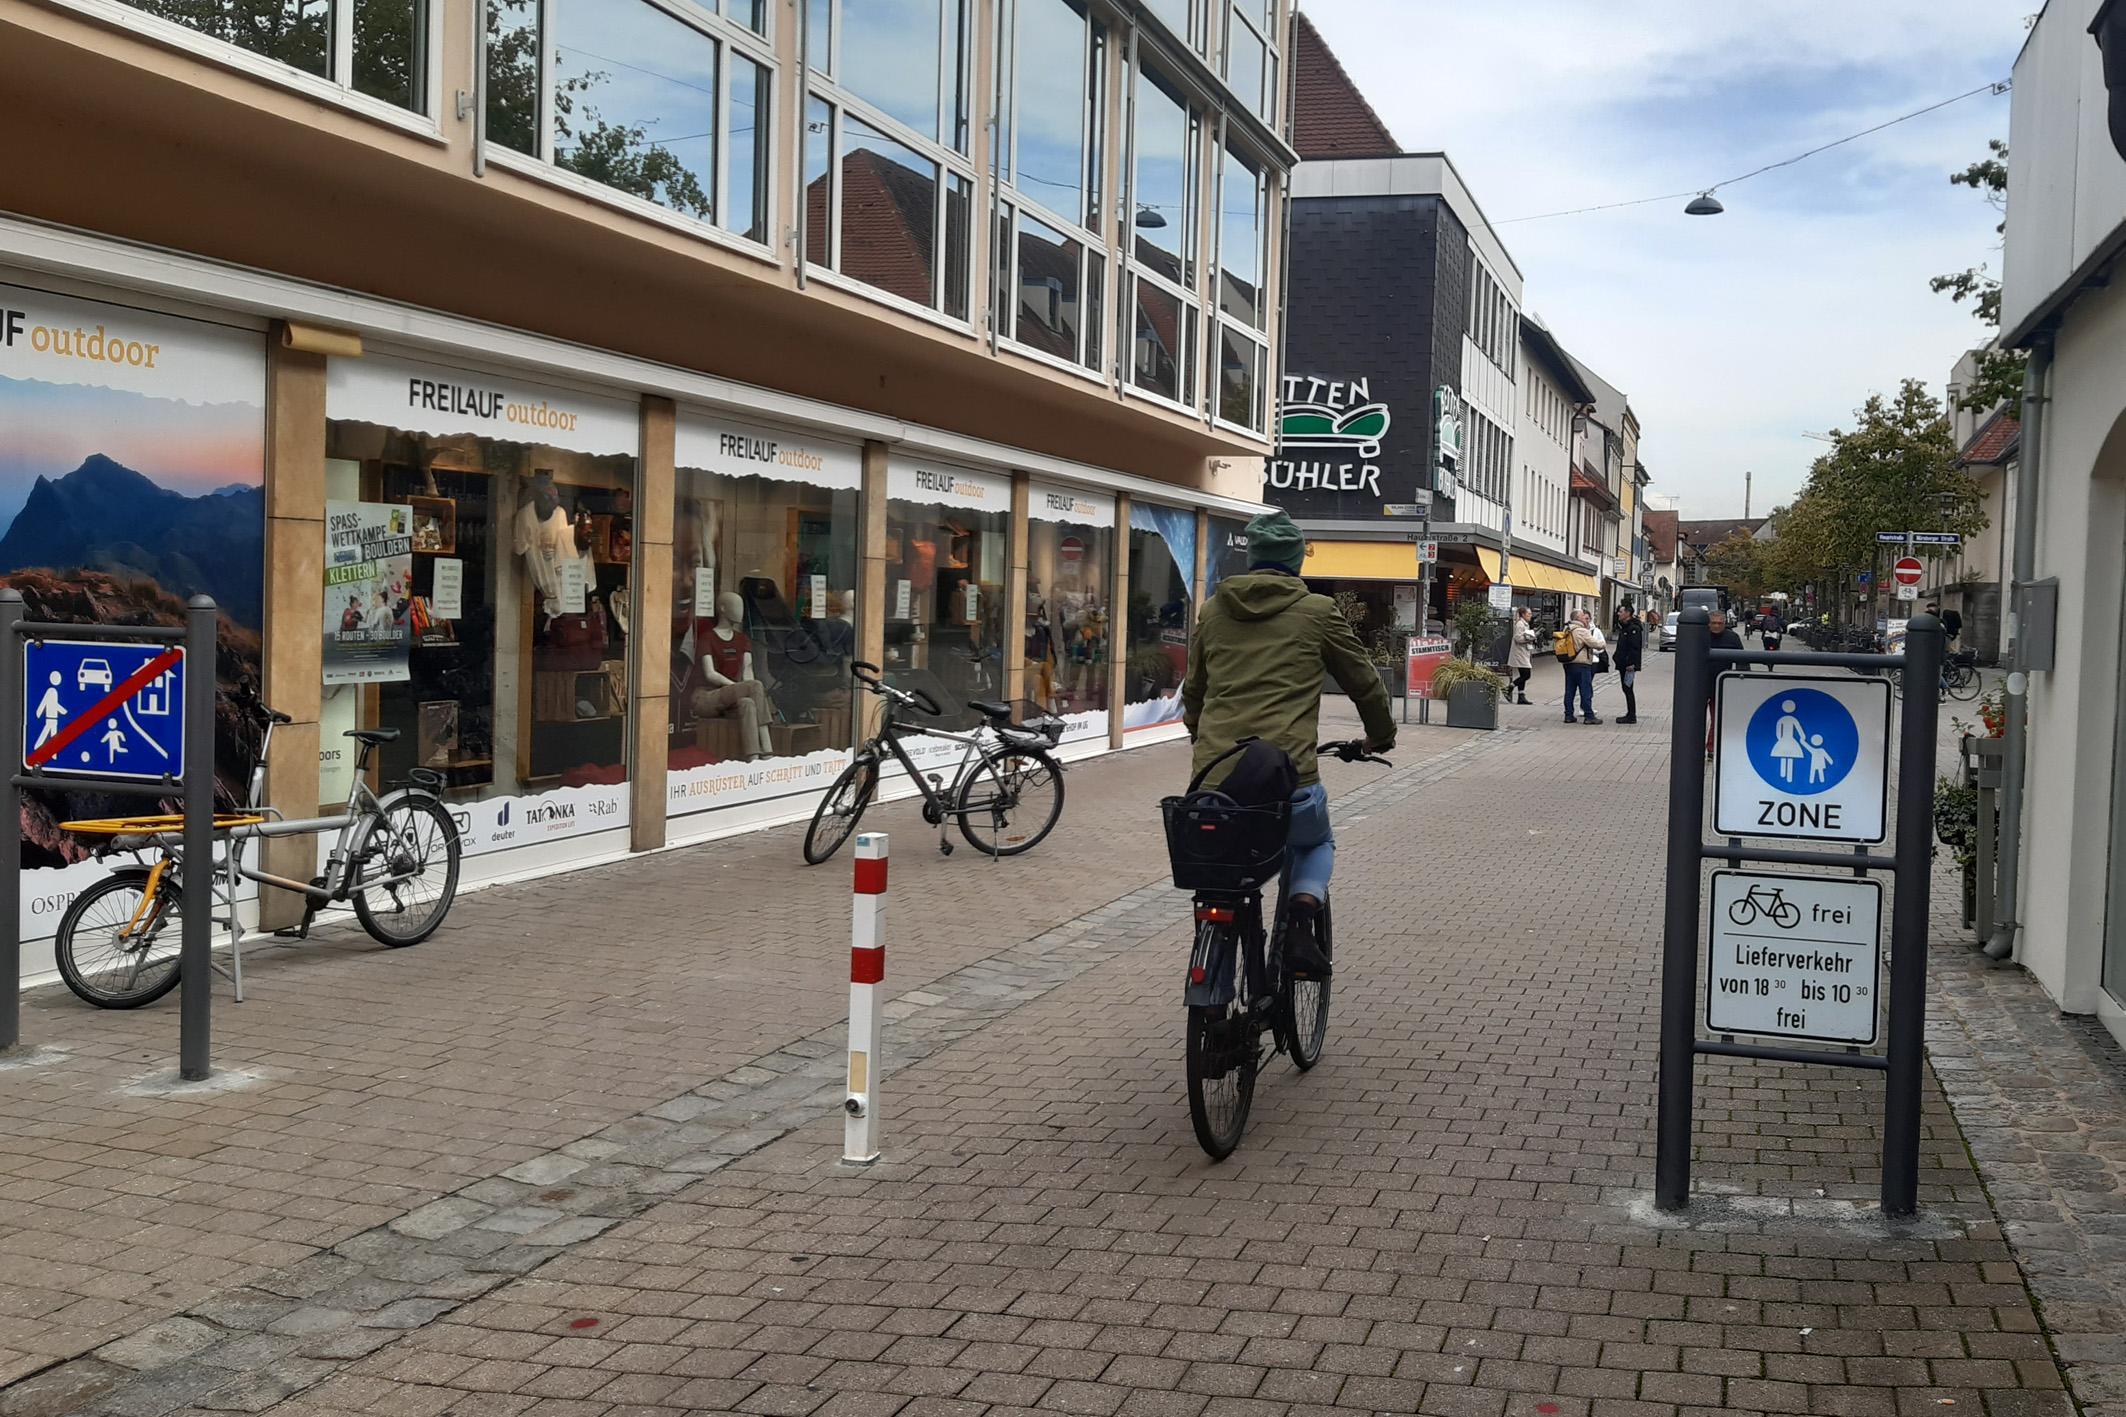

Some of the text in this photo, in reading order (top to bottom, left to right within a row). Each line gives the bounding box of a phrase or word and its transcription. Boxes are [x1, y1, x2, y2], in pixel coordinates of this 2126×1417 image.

[31, 325, 160, 368] outdoor
[409, 378, 578, 432] FREILAUF outdoor
[720, 433, 823, 471] FREILAUF outdoor
[916, 470, 985, 499] FREILAUF outdoor
[1046, 494, 1075, 512] FREILAUF
[330, 512, 362, 532] SPASS-
[1407, 533, 1458, 541] Haustraße
[364, 538, 410, 560] BOULDERN
[329, 561, 376, 584] KLETTERN
[1412, 644, 1449, 655] STAMMTISCH
[670, 759, 847, 800] IHR AUSRÜSTER AUF SCHRITT UND TRITT
[597, 797, 618, 816] Rab
[1757, 800, 1842, 829] ZONE
[491, 830, 516, 842] deuter
[31, 892, 76, 915] OSPR
[1812, 903, 1852, 924] frei
[1735, 944, 1854, 973] Lieferverkehr
[1719, 977, 1749, 995] von
[1801, 979, 1826, 1001] bis
[1776, 1007, 1806, 1030] frei
